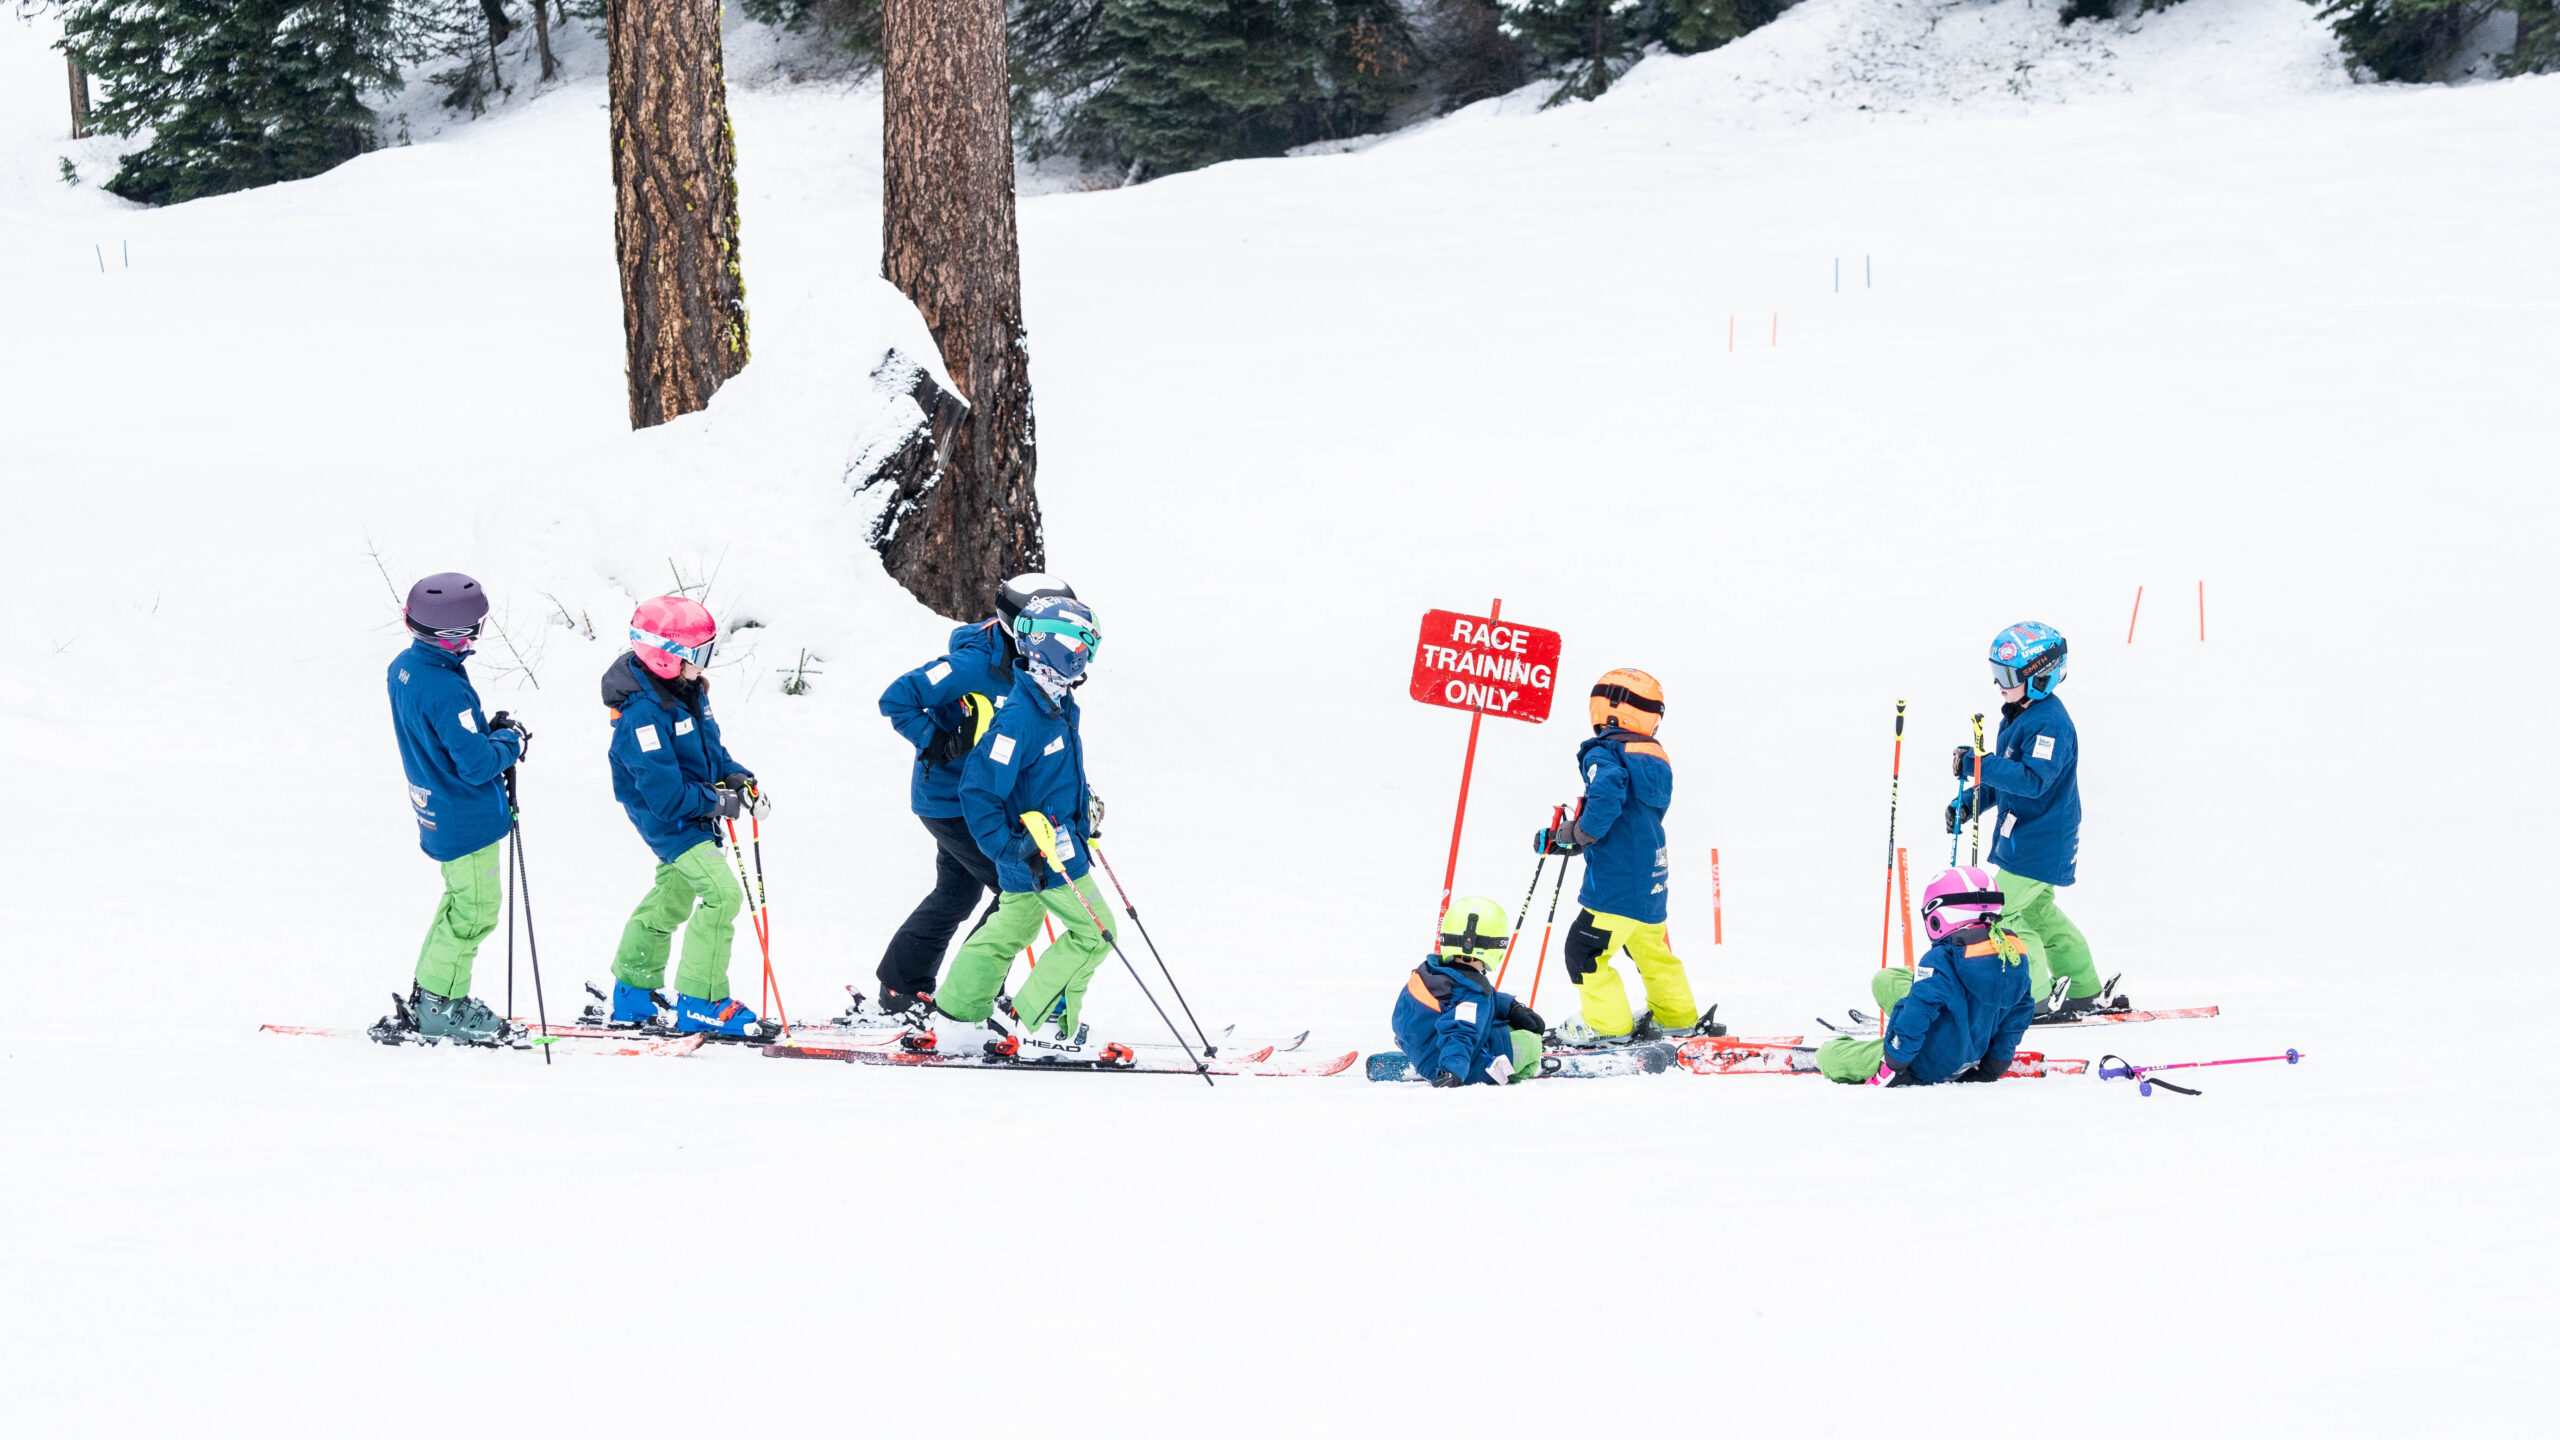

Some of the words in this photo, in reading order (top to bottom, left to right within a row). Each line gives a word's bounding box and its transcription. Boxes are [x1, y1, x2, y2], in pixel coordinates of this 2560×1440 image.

[1452, 619, 1530, 654] RACE
[2021, 645, 2046, 658] uvex
[1423, 644, 1552, 689] TRAINING
[2022, 656, 2048, 676] SMITH
[1445, 680, 1519, 712] ONLY
[1023, 1038, 1081, 1053] HEAD
